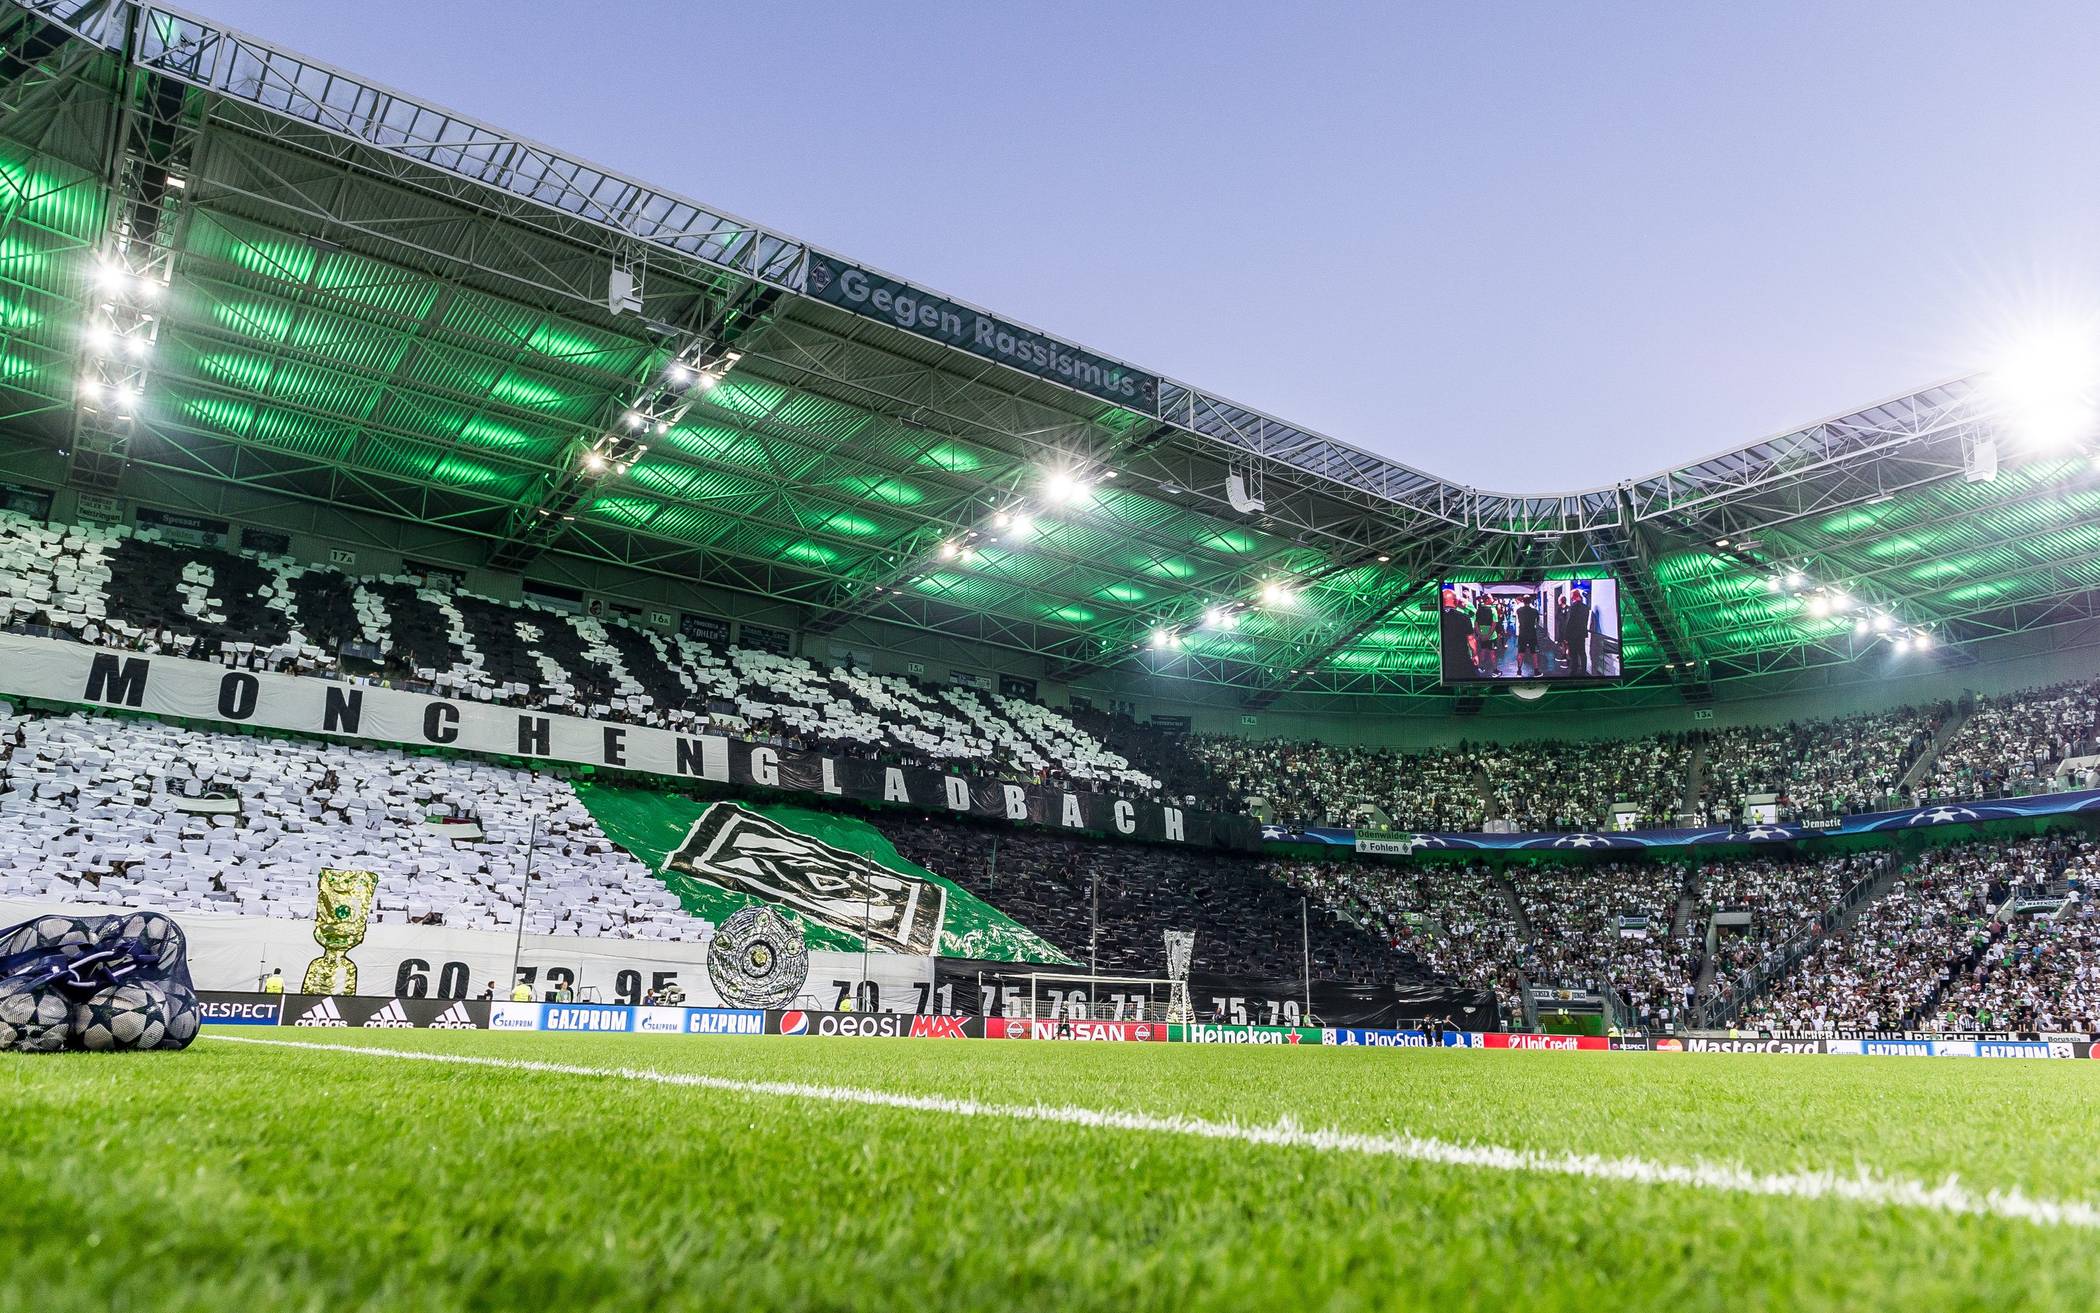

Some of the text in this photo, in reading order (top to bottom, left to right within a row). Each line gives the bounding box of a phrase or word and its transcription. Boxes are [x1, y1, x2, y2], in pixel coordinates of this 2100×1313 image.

[840, 269, 1136, 397] Gegen Rassismus
[652, 613, 669, 624] 16A
[1370, 842, 1399, 852] Fohlen
[197, 1002, 277, 1019] RESPECT
[294, 1017, 348, 1027] adidas
[504, 1009, 626, 1031] GAZPROM GAZPROM
[651, 1013, 761, 1034] GAZPROM GAZPROM
[819, 1014, 972, 1039] pepsi MAX
[1035, 1022, 1125, 1041] NISSAN
[1189, 1023, 1282, 1044] Heineken
[1521, 1035, 1578, 1050] UniCredit
[1688, 1038, 1819, 1055] MasterCard
[1867, 1043, 1928, 1056] GAZPROM
[1981, 1045, 2048, 1058] GAZPROM
